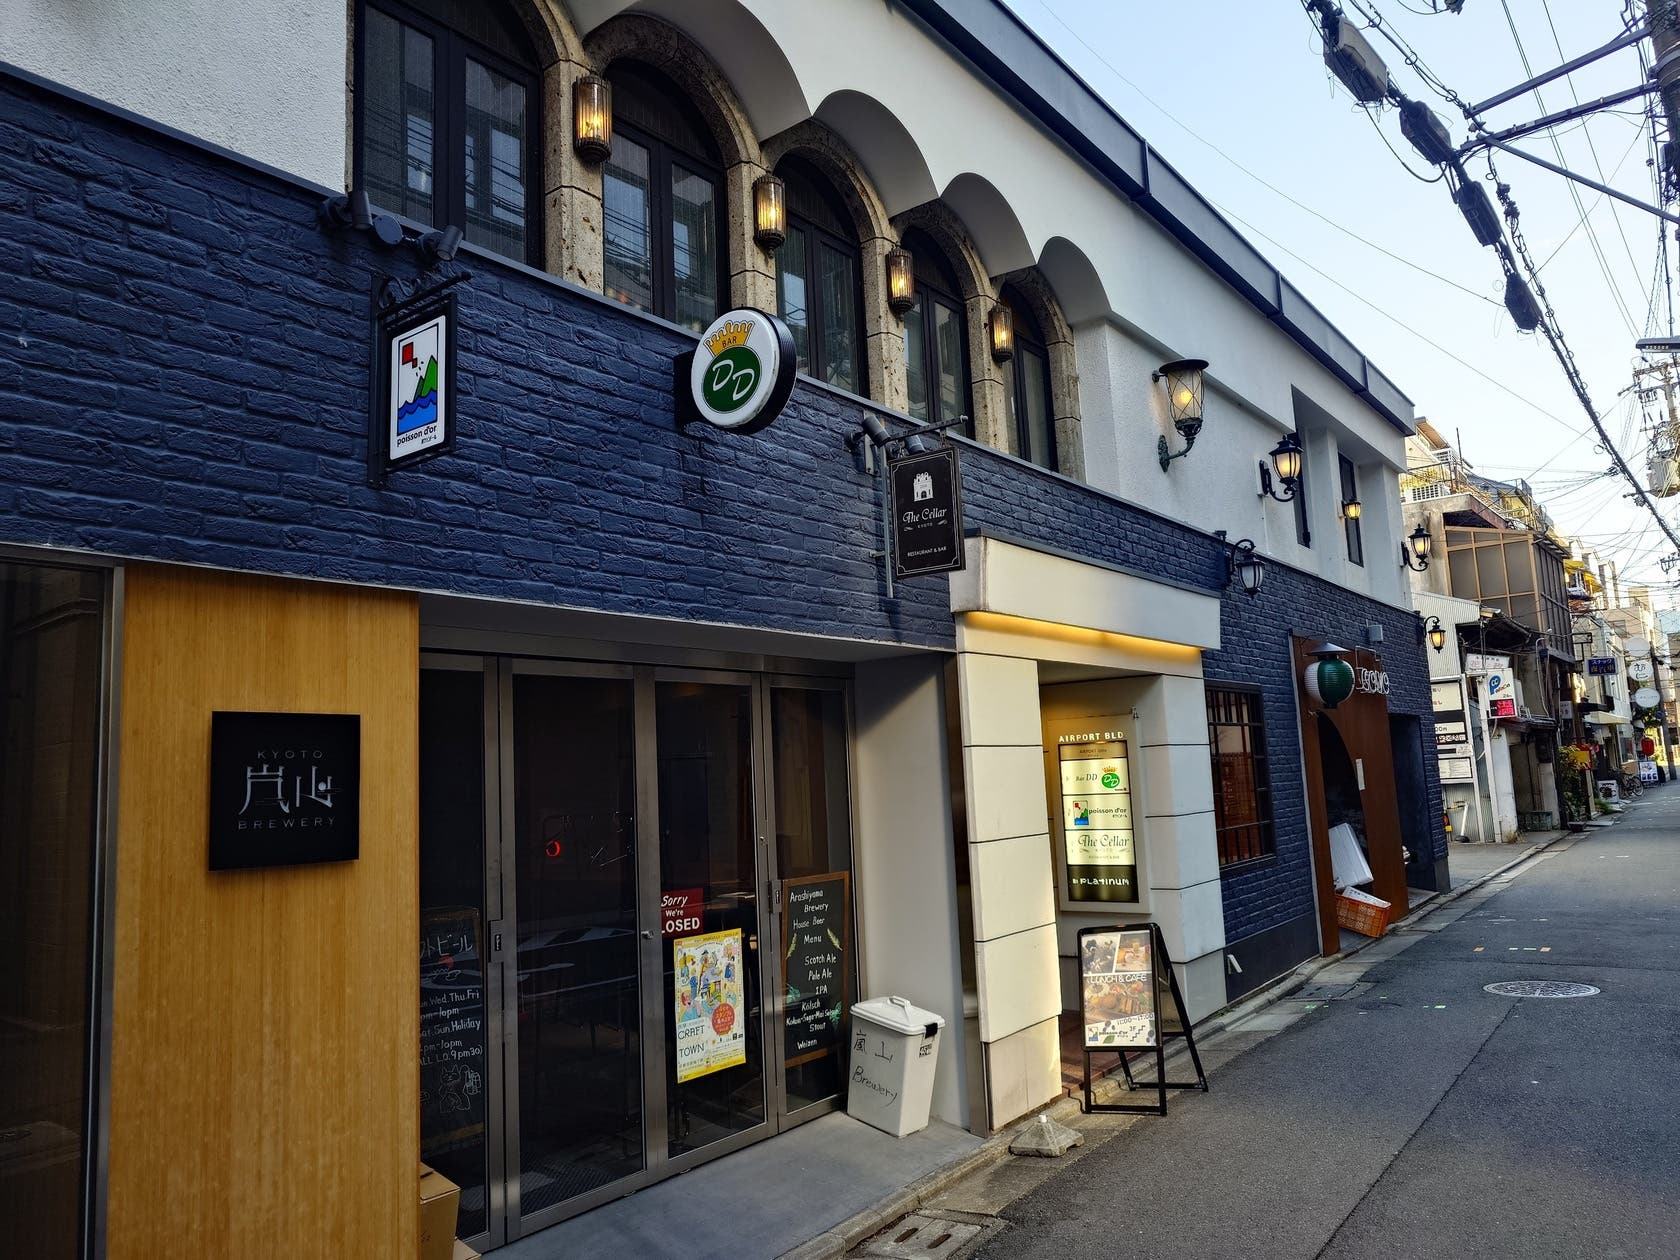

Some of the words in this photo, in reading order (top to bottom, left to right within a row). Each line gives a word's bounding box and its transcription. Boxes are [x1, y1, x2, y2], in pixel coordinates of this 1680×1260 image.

[722, 335, 737, 349] BAR
[712, 359, 755, 401] DD
[397, 427, 423, 447] poisson
[423, 423, 437, 436] d'or
[902, 510, 920, 524] The
[921, 507, 947, 521] Cellar
[1059, 732, 1100, 743] AIRPORT
[1104, 731, 1124, 740] BLD
[257, 749, 323, 760] KYOTO
[1086, 773, 1098, 781] DD
[1088, 807, 1113, 815] poisson
[238, 816, 336, 831] BREWERY
[1077, 834, 1098, 847] The
[1100, 834, 1130, 847] Cellar
[661, 894, 689, 908] Sorry
[789, 889, 824, 903] Arashiyama
[665, 908, 684, 917] We're
[803, 902, 829, 913] Brewery
[661, 917, 700, 933] OSED
[793, 918, 810, 930] House
[812, 915, 825, 926] Beer
[803, 933, 822, 945] Menu
[804, 953, 825, 966] Scotch
[826, 952, 837, 964] Ale
[808, 969, 821, 981] Pale
[821, 967, 833, 979] Ale
[815, 984, 828, 995] IPA
[421, 1017, 481, 1037] at.Sun.Holiday
[678, 1024, 705, 1040] CRAFT
[679, 1042, 705, 1058] TOWN
[852, 1065, 898, 1108] Brewery
